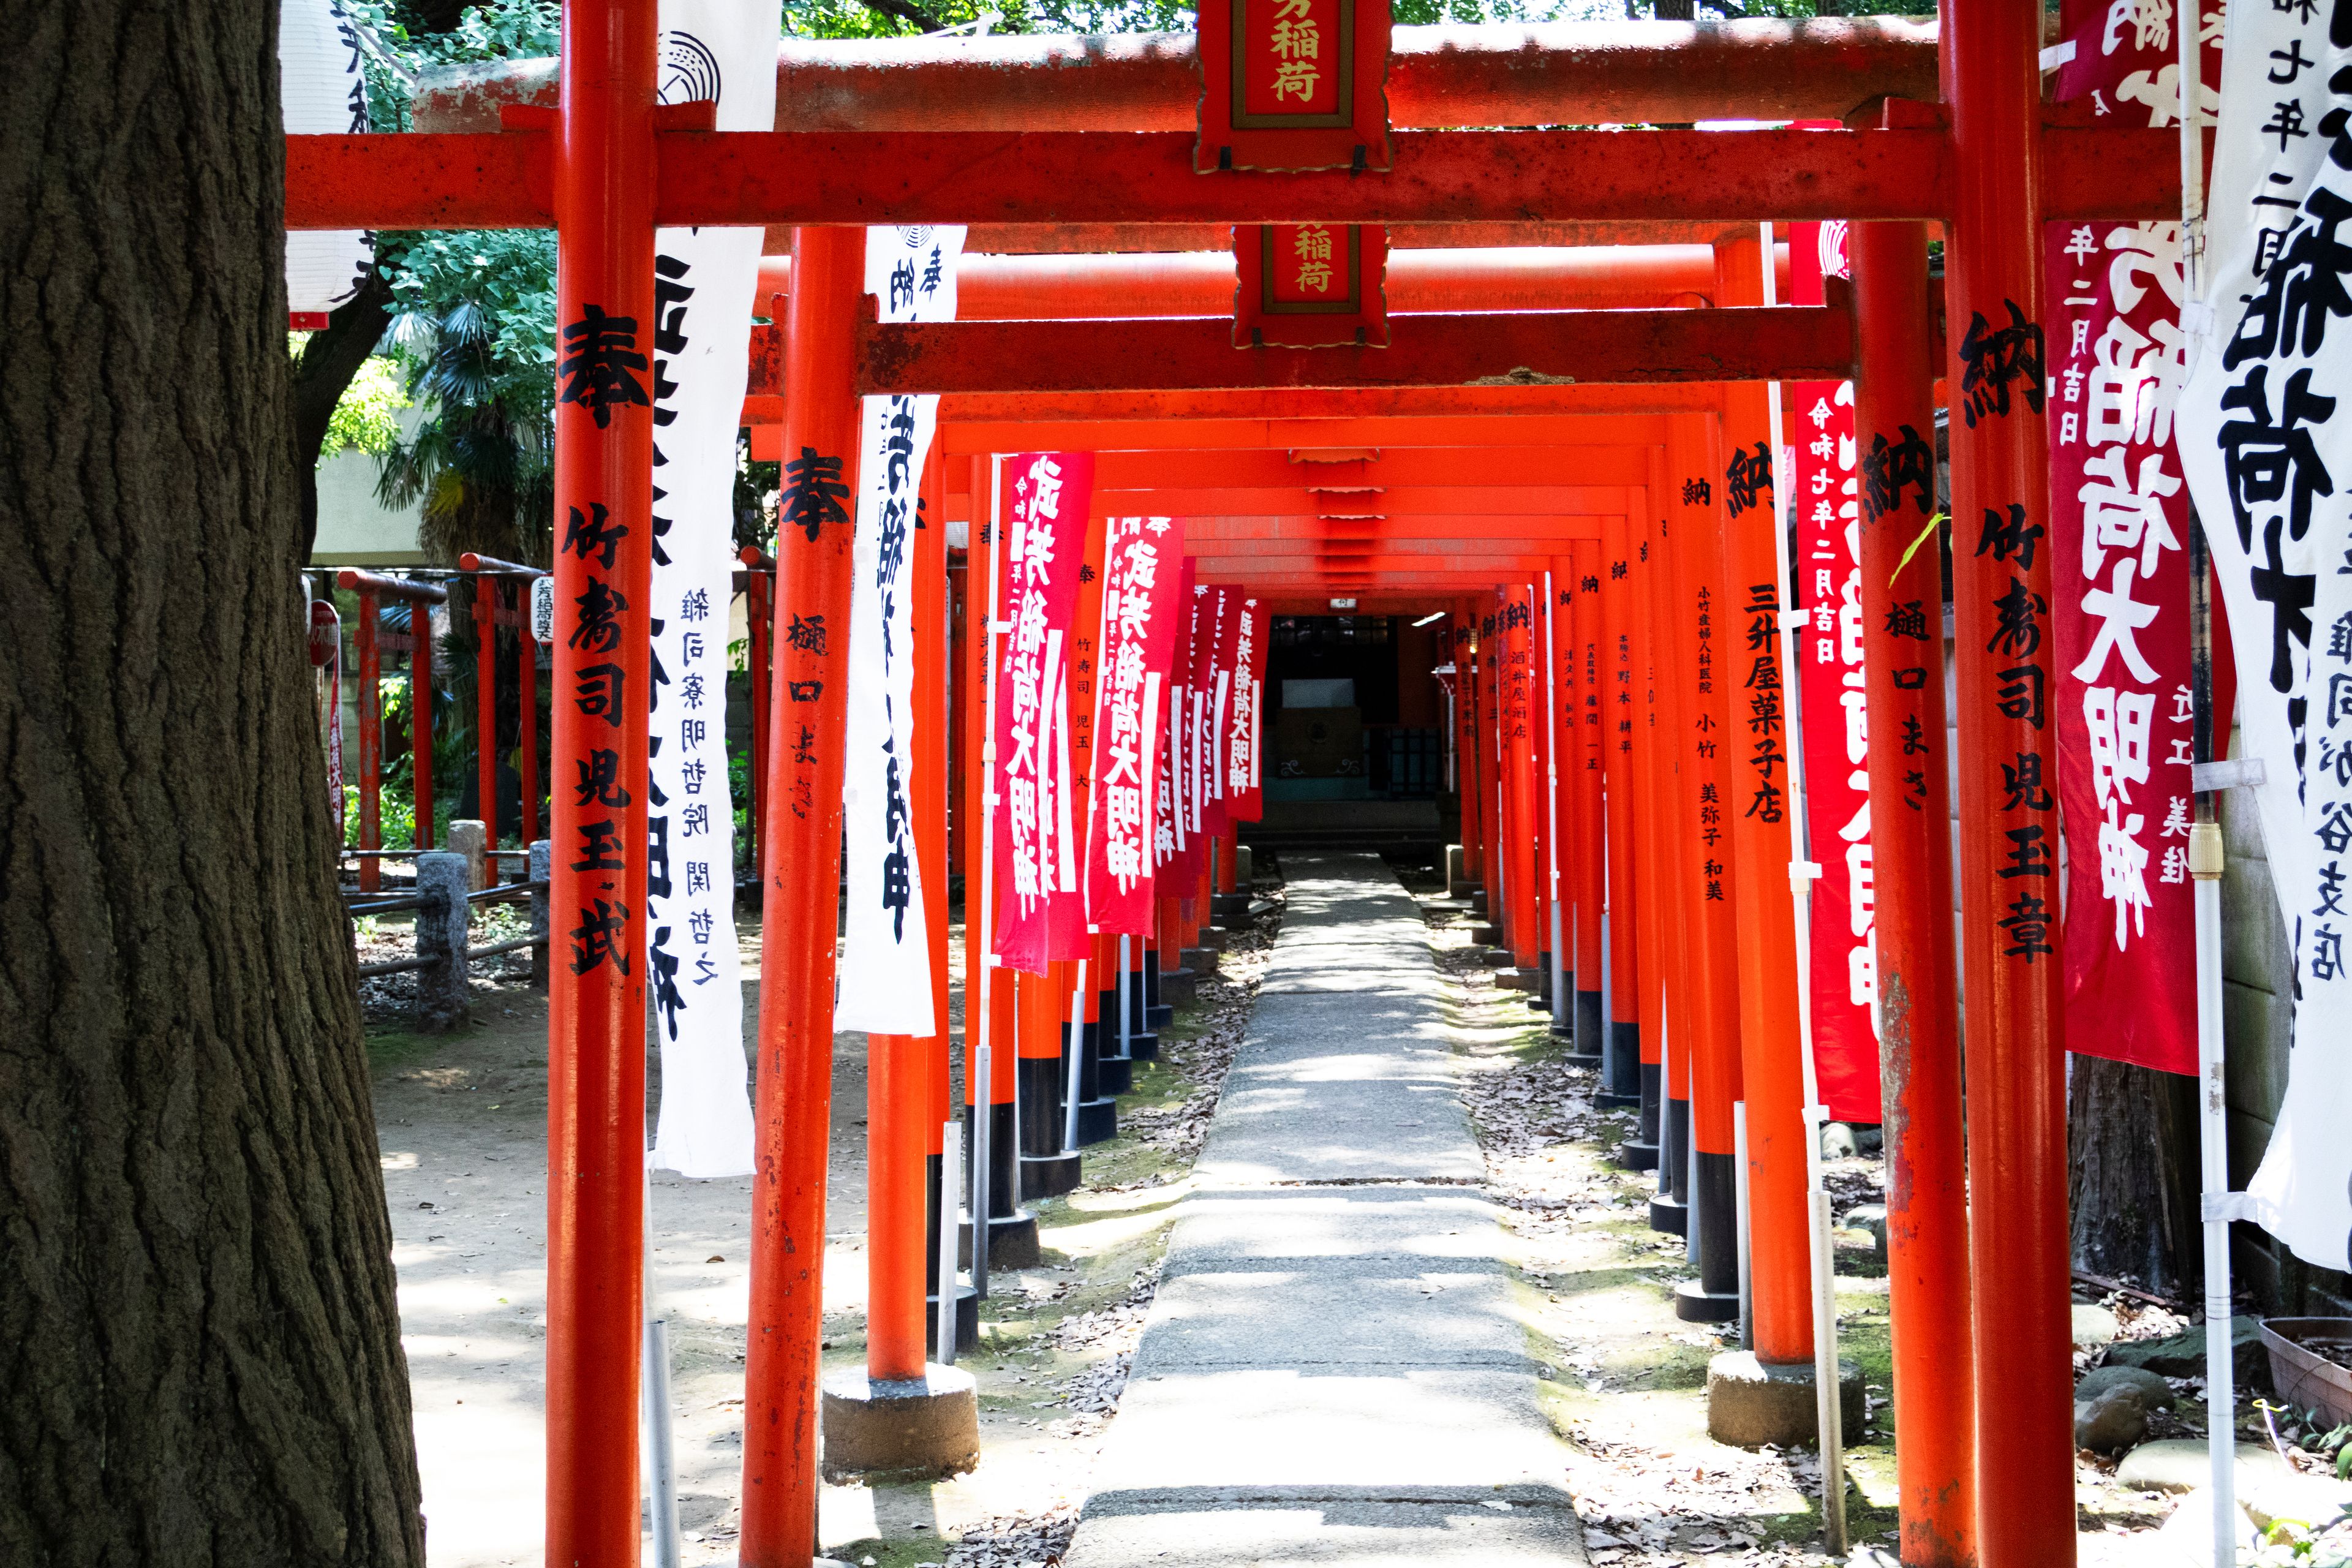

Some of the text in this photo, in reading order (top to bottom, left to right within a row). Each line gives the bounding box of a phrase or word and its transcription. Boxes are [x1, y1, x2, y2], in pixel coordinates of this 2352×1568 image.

[1294, 225, 1333, 293] 稲荷
[559, 303, 650, 429] 奉
[1958, 298, 2046, 428] 納
[781, 447, 850, 543] 奉
[1681, 478, 1711, 507] 納
[1726, 440, 1774, 521] 納
[1862, 424, 1934, 524] 納
[1079, 564, 1096, 584] 奉
[1507, 601, 1529, 630] 納
[1581, 575, 1599, 594] 納
[1077, 638, 1091, 695] 竹寿司
[1510, 650, 1528, 739] 酒井屋酒店
[1743, 584, 1784, 824] 三升屋菓子店
[1883, 600, 1931, 811] 樋口まさ
[1076, 715, 1090, 749] 児玉
[1695, 586, 1725, 902] 小竹産婦人科医院 小竹 美弥子 和美
